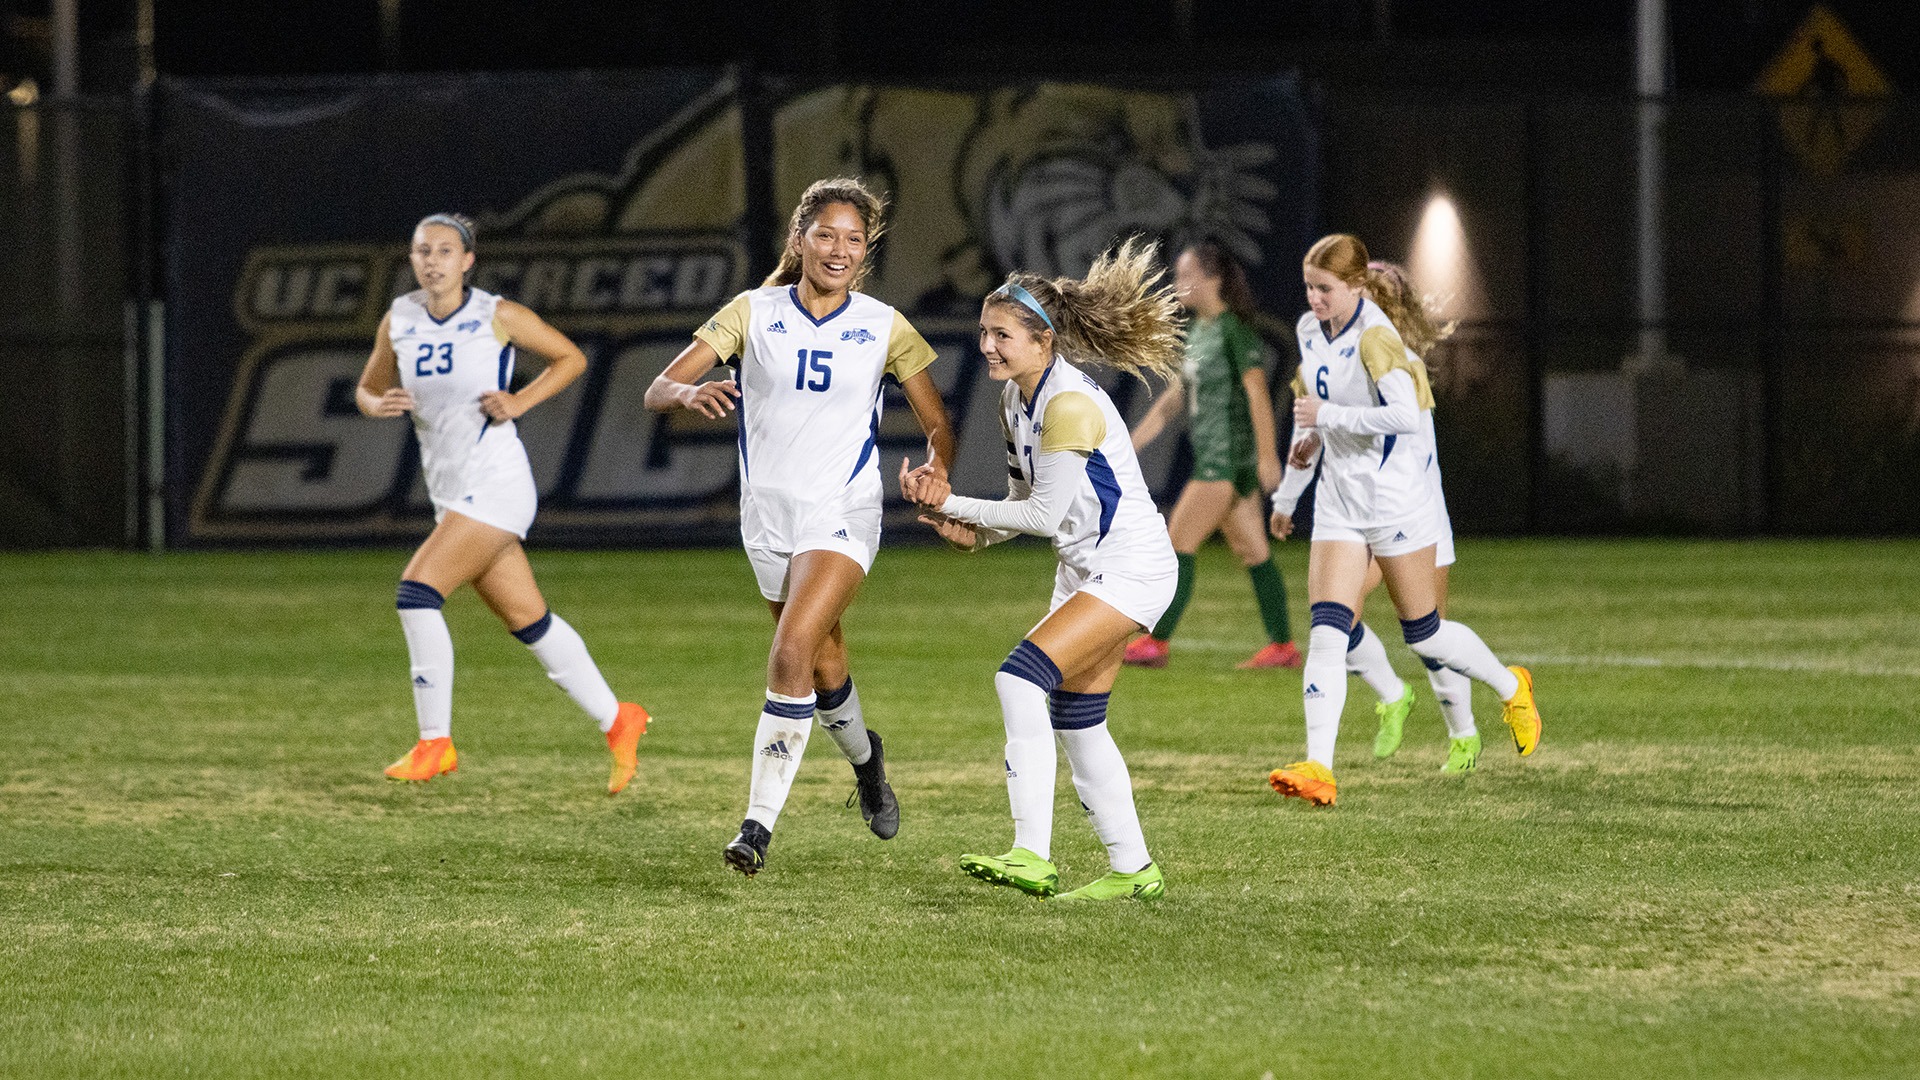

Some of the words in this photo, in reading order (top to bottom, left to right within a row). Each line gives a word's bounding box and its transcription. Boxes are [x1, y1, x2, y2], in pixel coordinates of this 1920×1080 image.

[252, 264, 364, 314] UC
[391, 256, 727, 308] ERCED
[416, 343, 453, 377] 23
[795, 348, 833, 392] 15
[1316, 365, 1329, 400] 6
[1023, 445, 1034, 487] 7
